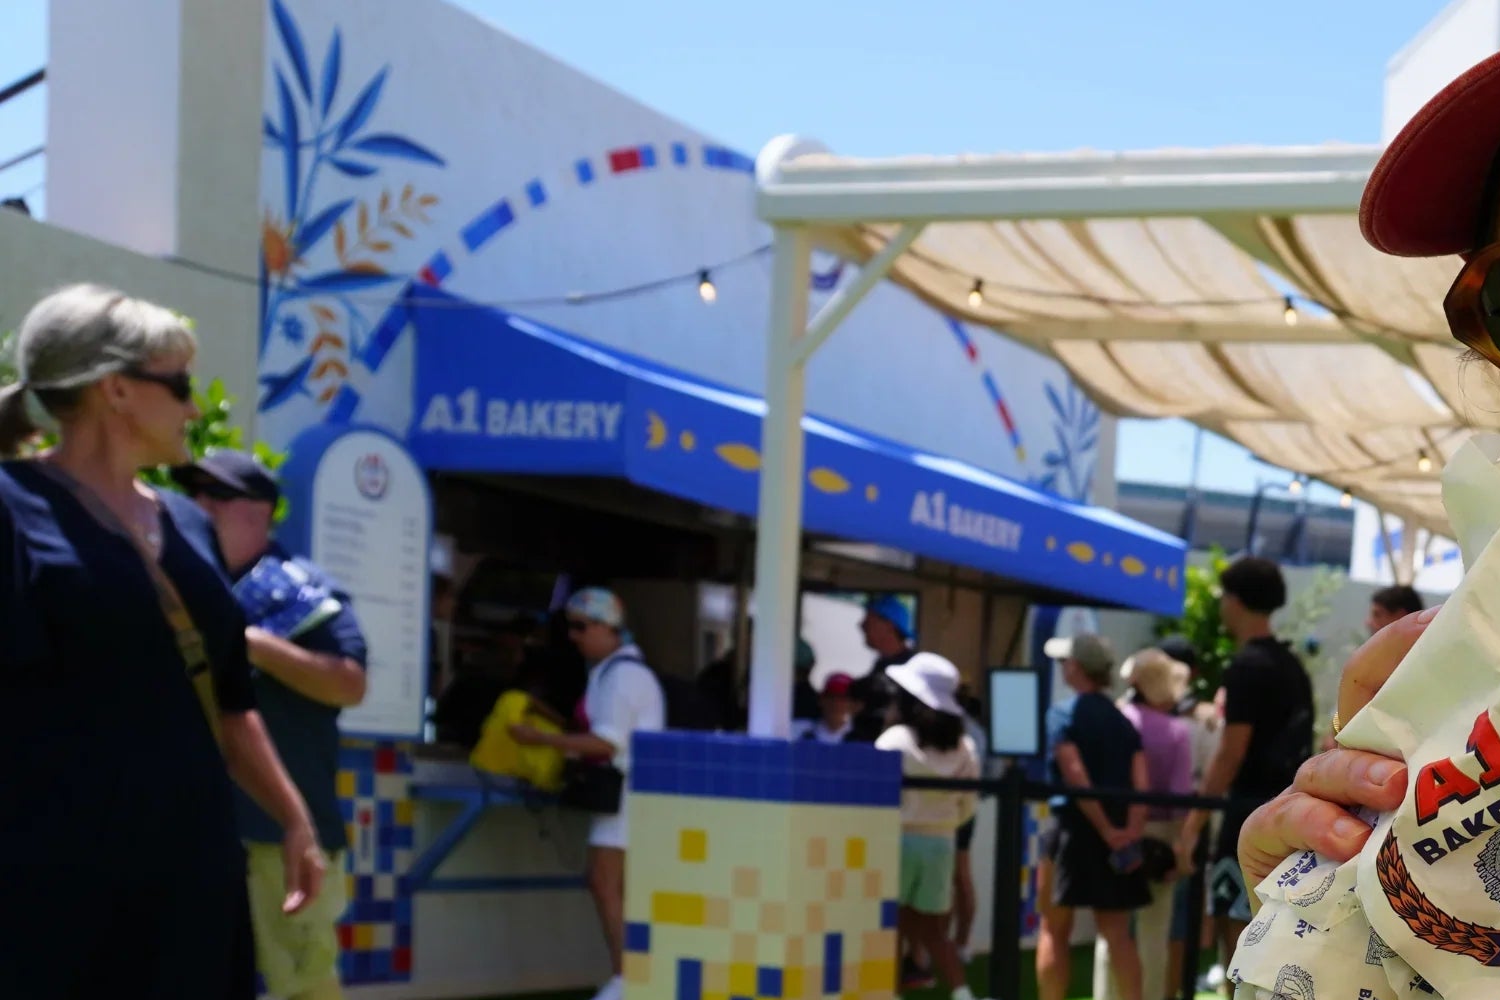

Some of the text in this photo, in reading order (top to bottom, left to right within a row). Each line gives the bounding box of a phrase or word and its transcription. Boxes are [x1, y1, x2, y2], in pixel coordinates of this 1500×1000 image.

[421, 387, 622, 440] A1 BAKERY
[911, 490, 1023, 552] A1 BAKERY
